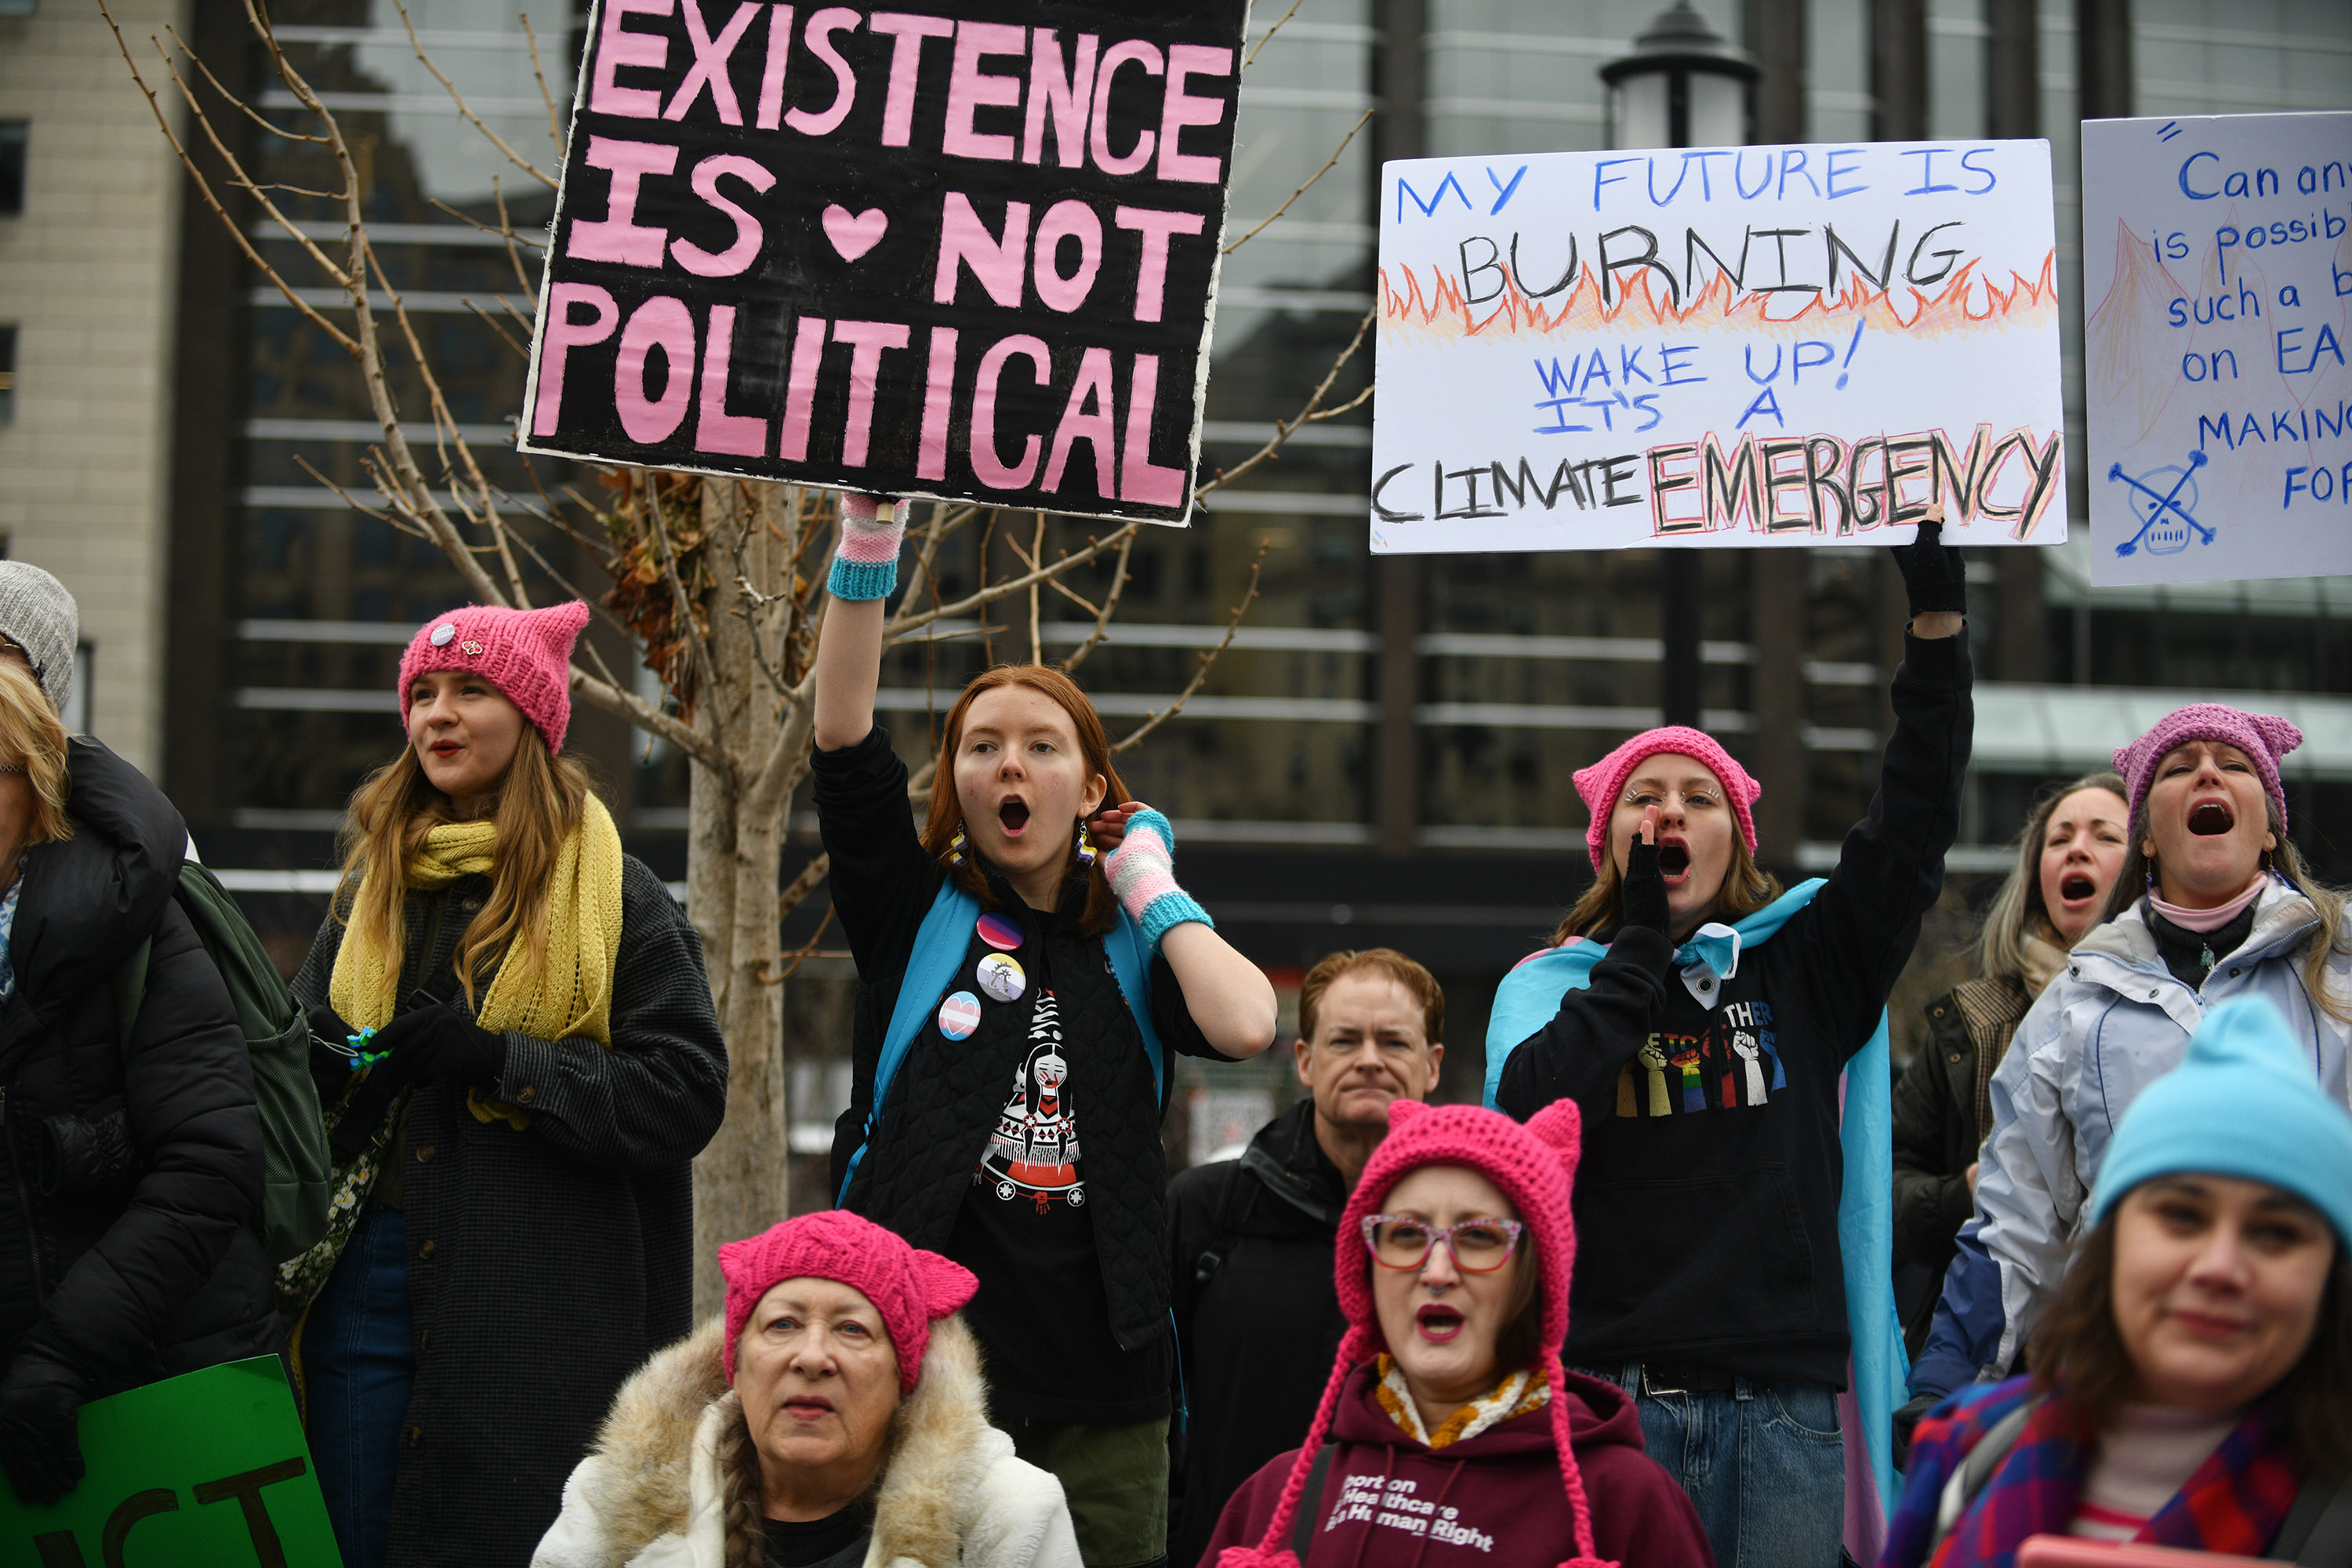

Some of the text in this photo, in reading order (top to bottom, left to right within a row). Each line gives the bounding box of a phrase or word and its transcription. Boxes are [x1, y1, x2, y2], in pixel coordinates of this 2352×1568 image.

[590, 0, 1234, 184] EXISTENCE
[1396, 148, 1997, 224] MY FUTURE IS
[2297, 161, 2352, 195] an
[566, 136, 1205, 323] IS NOT
[1459, 219, 1966, 306] BURNING
[2152, 201, 2352, 285] is possib
[2168, 276, 2260, 328] such
[2278, 285, 2300, 307] a
[1534, 316, 1867, 398] WAKE UP!
[2182, 323, 2346, 382] on EA
[532, 281, 1196, 507] POLITICAL
[1533, 385, 1785, 434] IT'S A
[2199, 400, 2352, 450] MAKIN
[1372, 423, 2064, 543] CLIMATE EMERGENCY
[1430, 1519, 1494, 1553] Right
